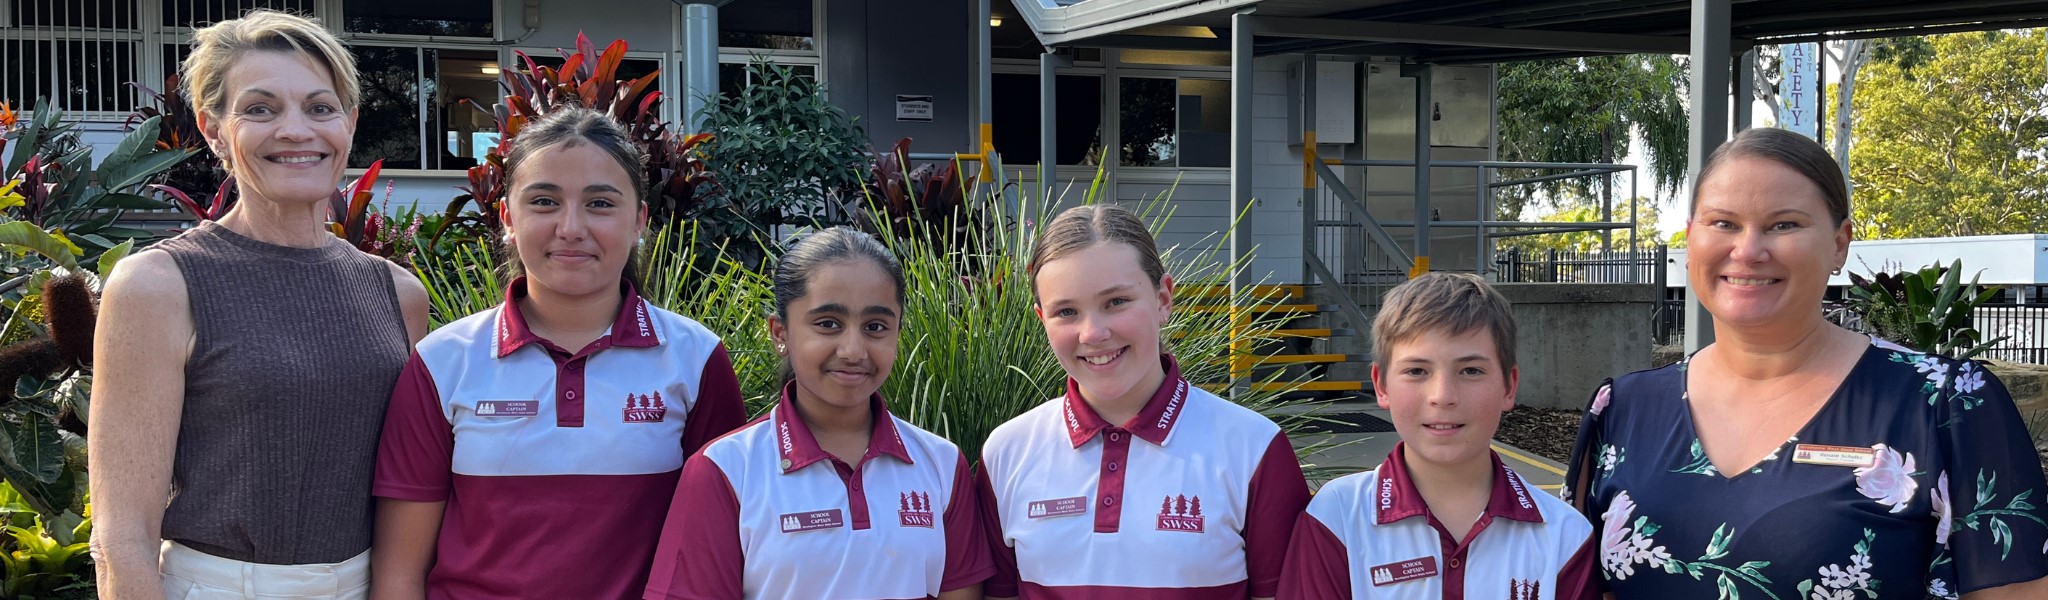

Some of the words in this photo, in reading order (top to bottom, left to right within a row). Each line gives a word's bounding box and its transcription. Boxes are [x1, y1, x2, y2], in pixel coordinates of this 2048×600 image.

[628, 411, 662, 421] SWSS
[781, 421, 793, 455] SCHOOL
[1381, 477, 1393, 510] SCHOOL
[905, 515, 931, 525] SWSS
[1162, 519, 1198, 530] SWSS
[1401, 560, 1423, 568] SCHOOL
[1402, 566, 1425, 575] CAPTAIN
